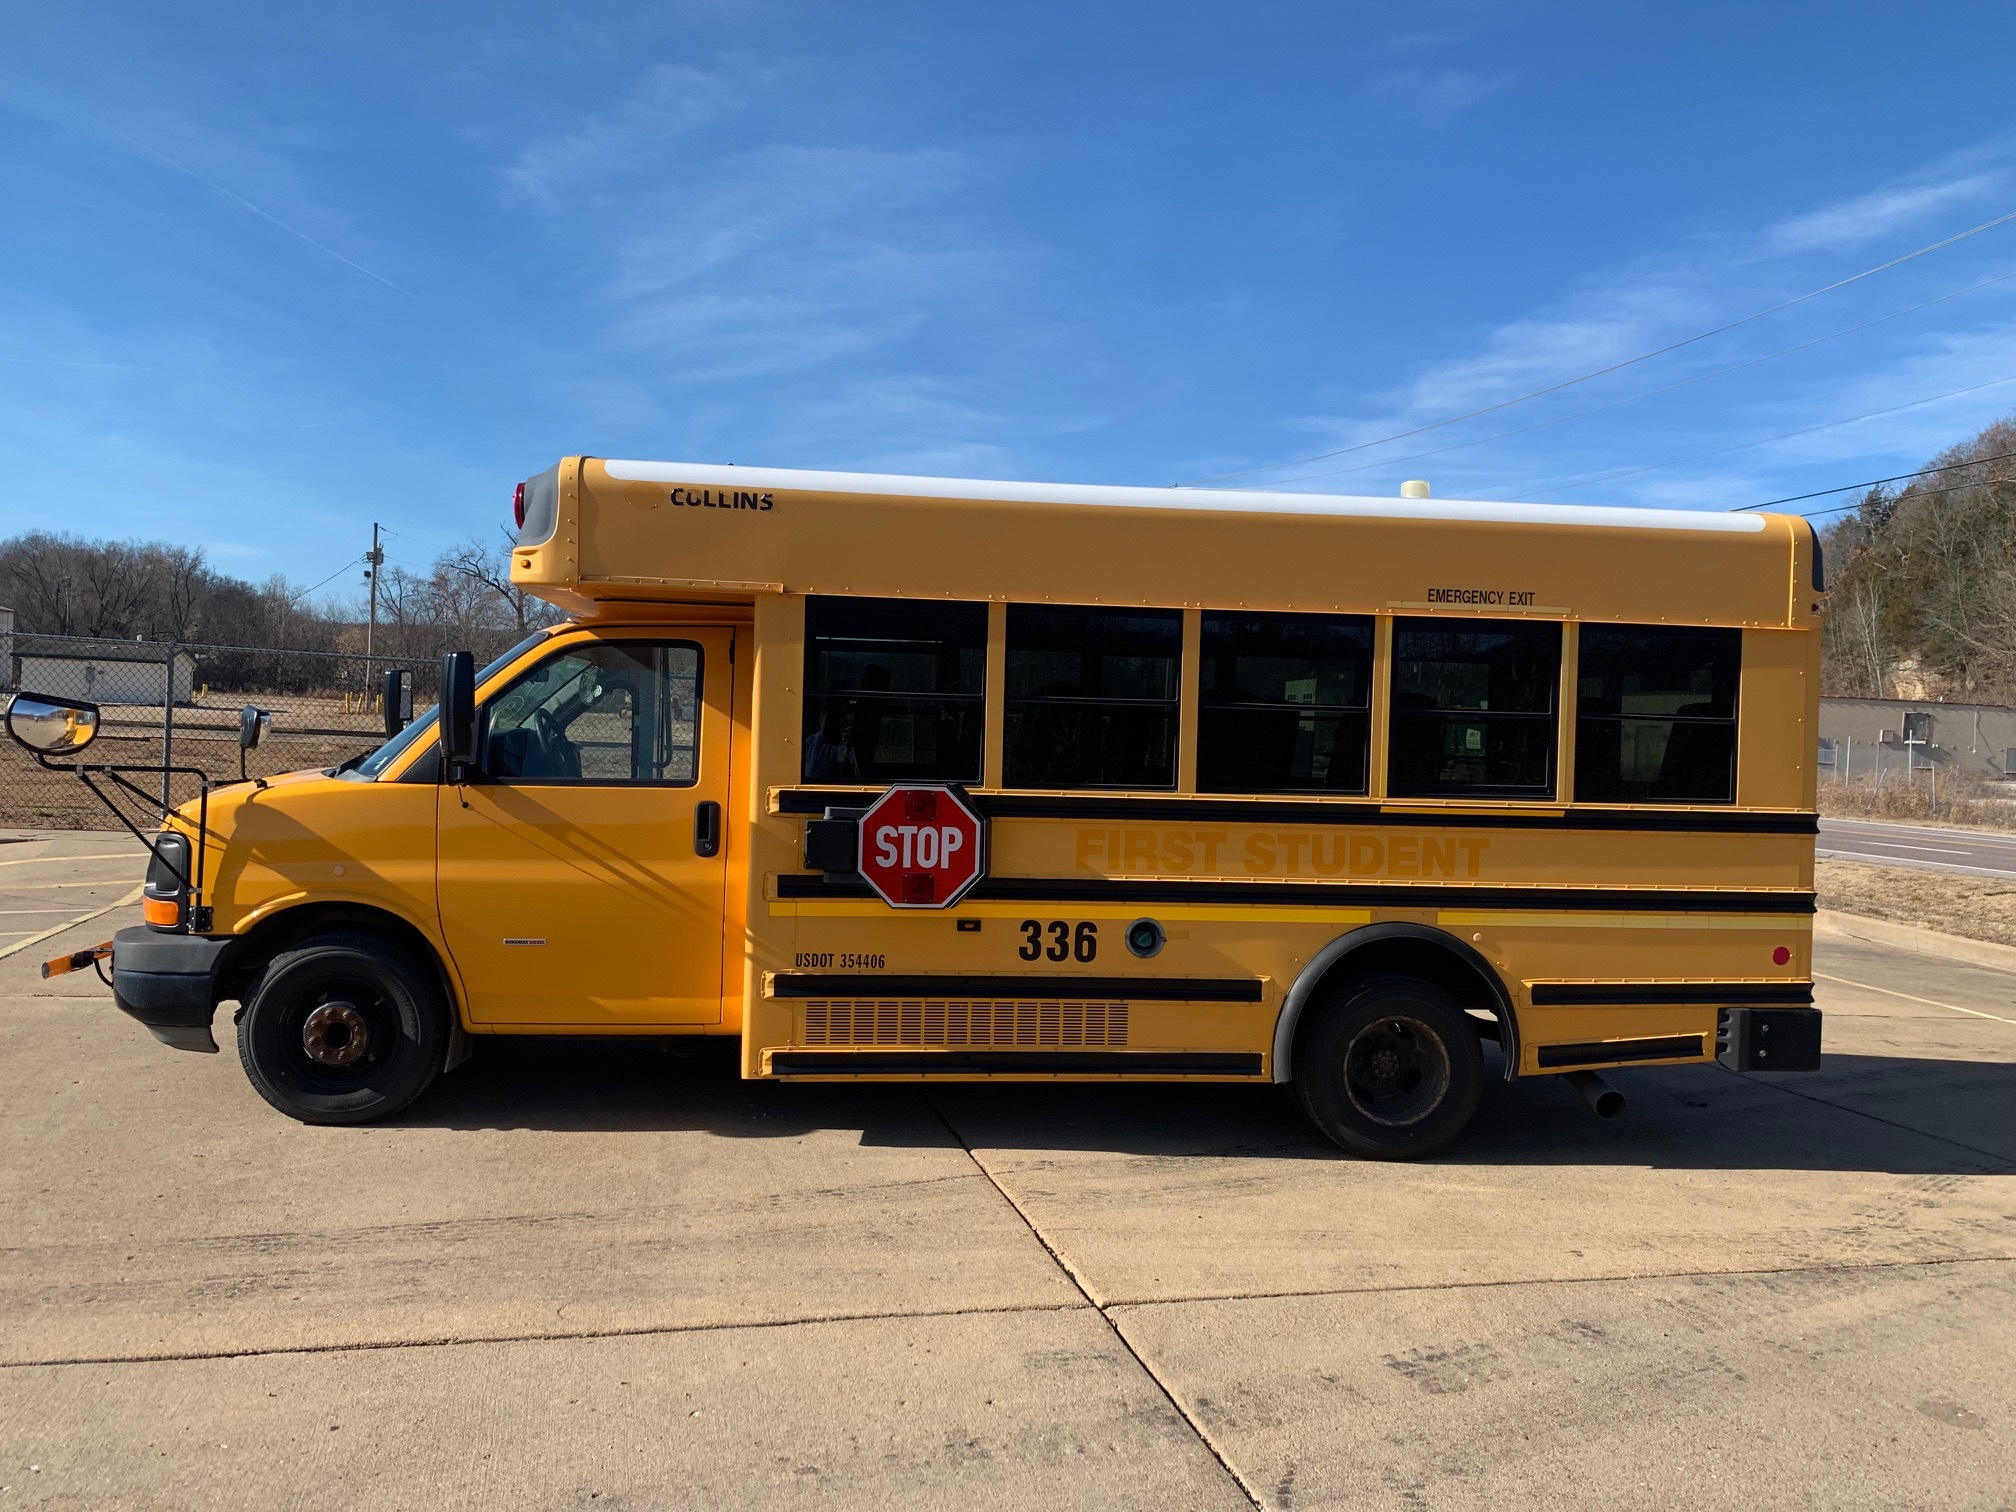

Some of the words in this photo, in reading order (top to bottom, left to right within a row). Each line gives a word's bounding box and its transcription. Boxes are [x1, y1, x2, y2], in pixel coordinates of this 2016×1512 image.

[670, 488, 774, 511] COLLINS
[1427, 588, 1504, 605] EMERGENCY
[1509, 591, 1536, 606] EXIT
[875, 825, 963, 868] STOP
[1076, 829, 1227, 872] FIRST
[1243, 833, 1490, 877] STUDENT
[1018, 920, 1098, 963] 336
[795, 953, 835, 968] USDOT
[840, 953, 885, 969] 354406
